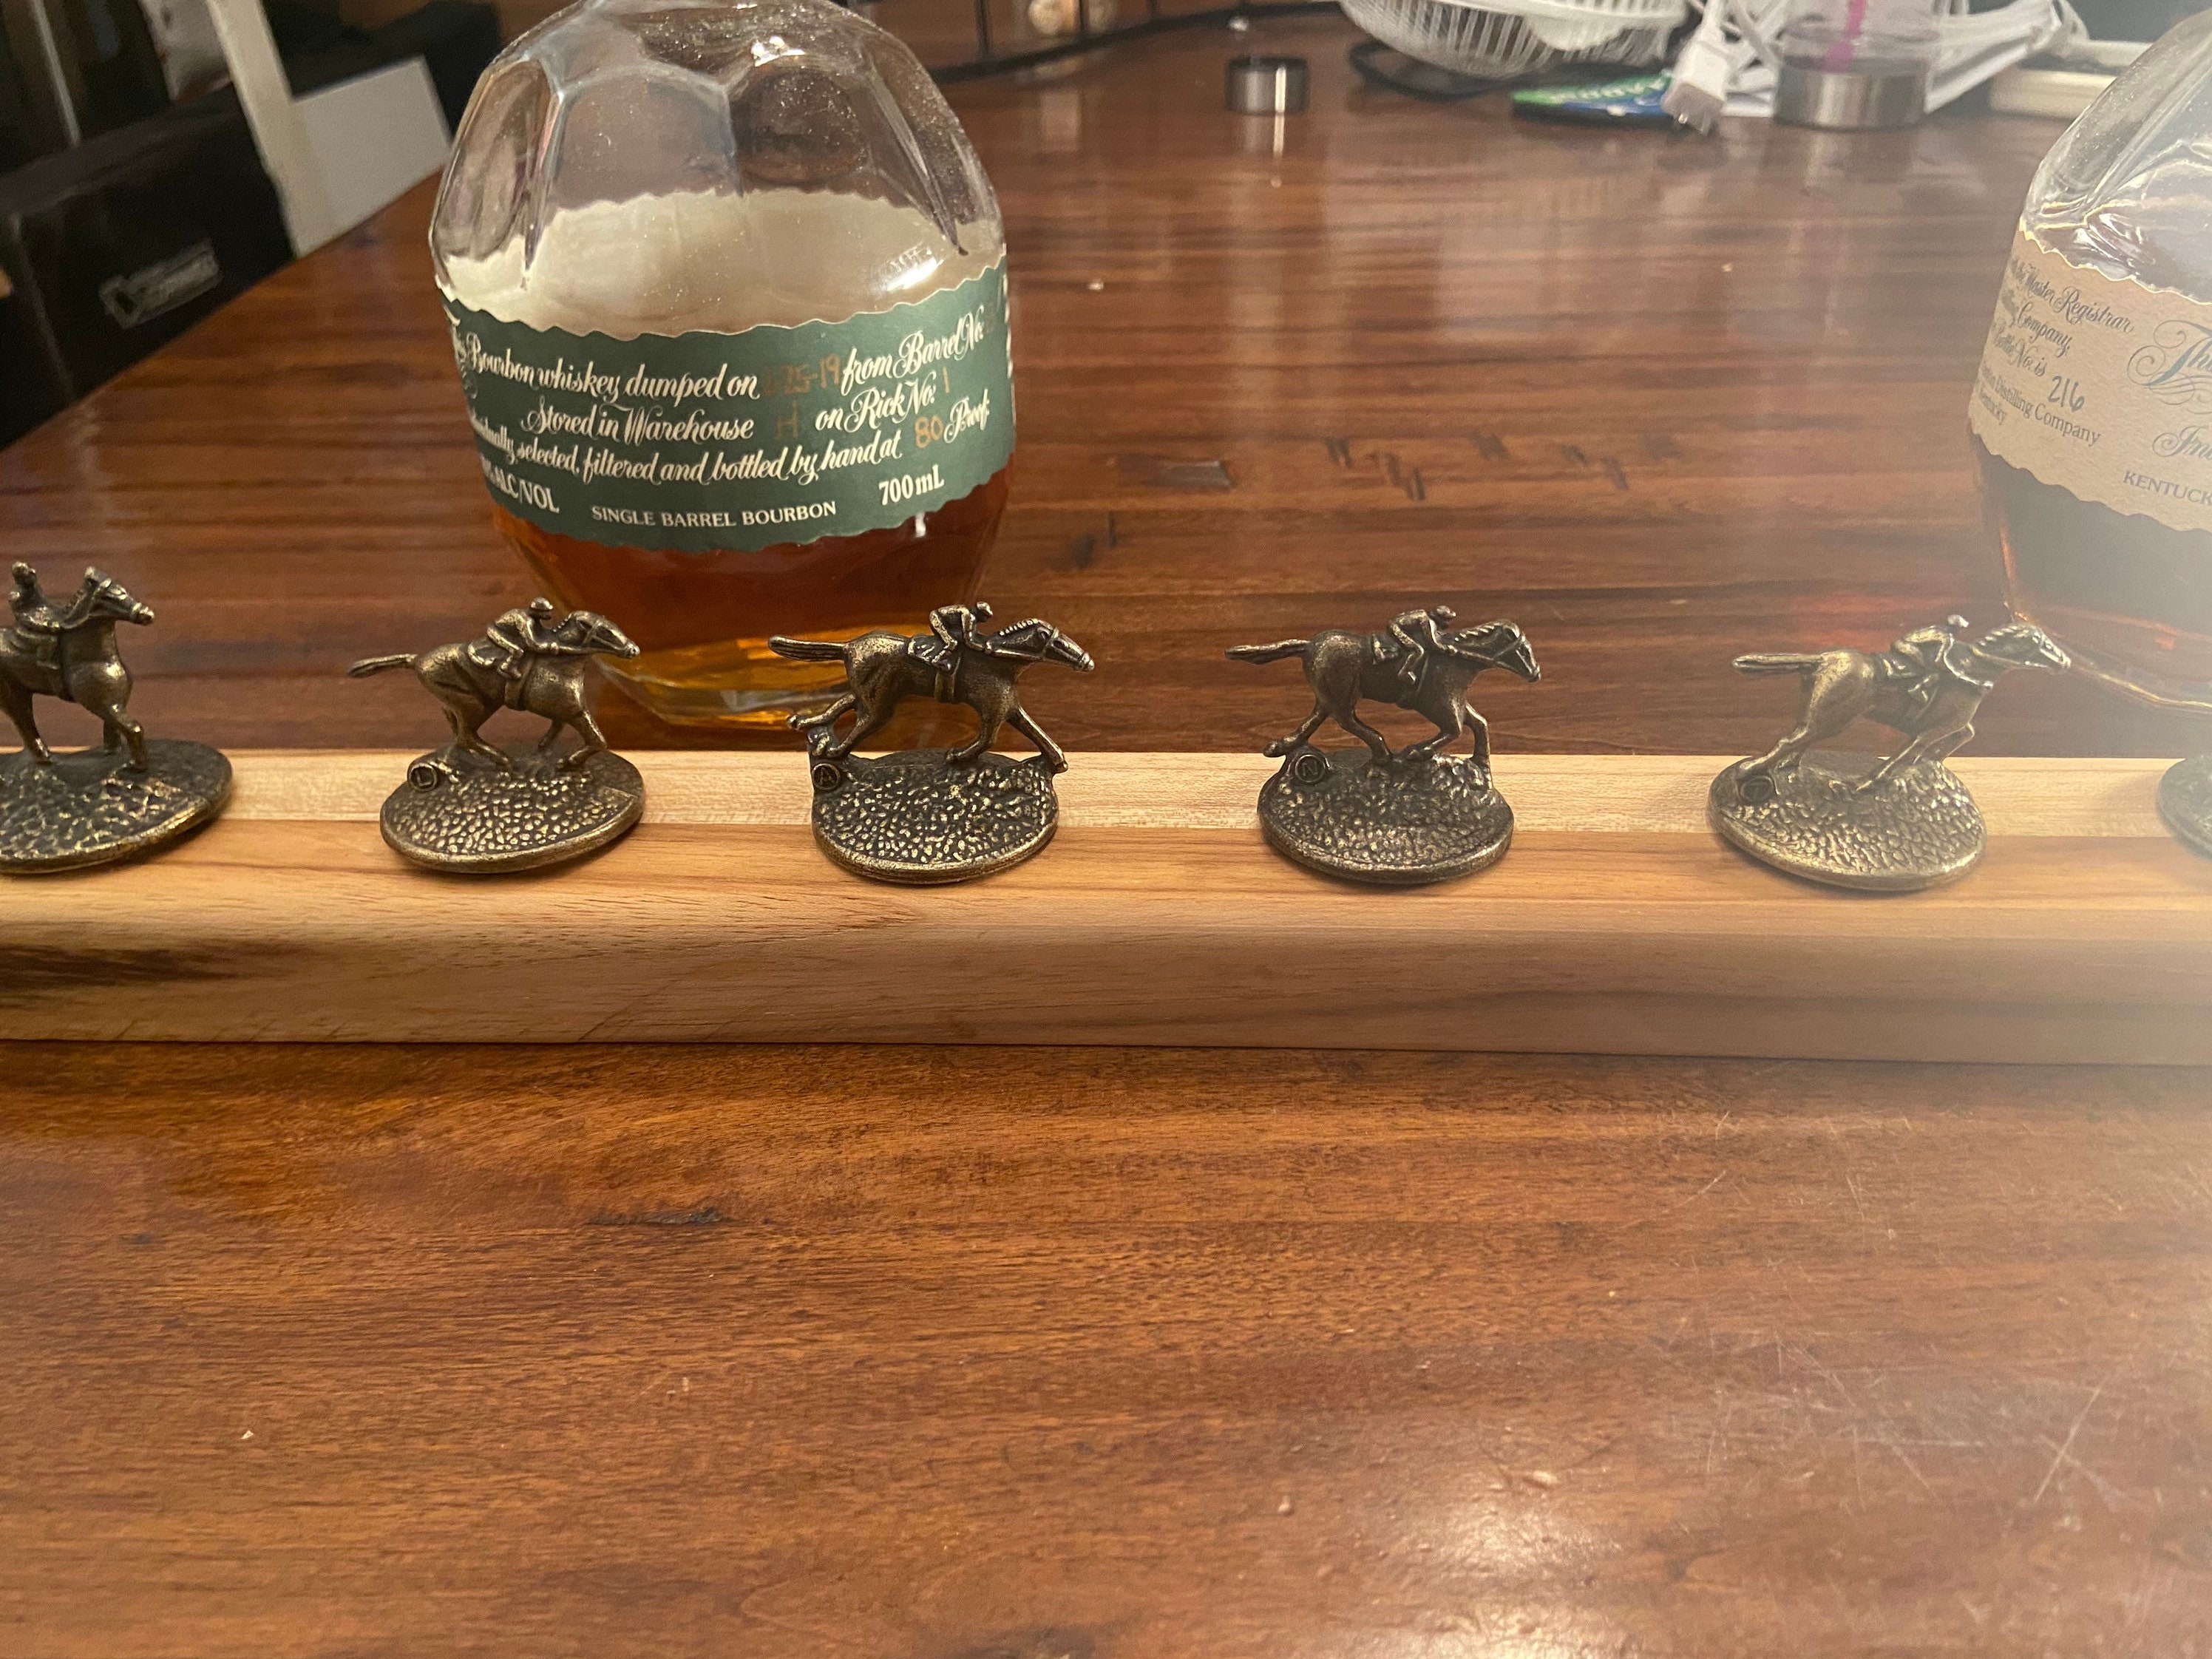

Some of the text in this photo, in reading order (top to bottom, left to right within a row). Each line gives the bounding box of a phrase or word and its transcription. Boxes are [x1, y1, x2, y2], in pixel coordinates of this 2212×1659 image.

[2017, 263, 2055, 307] Master
[2053, 286, 2134, 333] Registrar
[466, 332, 540, 390] Bourbon
[537, 358, 621, 404] whiskey
[625, 363, 725, 407] dumped
[727, 373, 761, 400] on
[841, 346, 893, 397] from
[892, 317, 964, 379] Barrel
[2034, 357, 2049, 377] is
[844, 382, 905, 433] Rick
[2047, 376, 2085, 413] 216
[520, 395, 597, 441] Stored
[597, 410, 622, 443] in
[600, 402, 755, 447] Warehouse
[815, 407, 844, 432] on
[2034, 403, 2101, 447] Company
[583, 446, 662, 486] filtered
[660, 452, 710, 486] and
[708, 446, 789, 487] bottled
[789, 445, 819, 486] by
[819, 429, 882, 472] hand
[880, 429, 903, 460] at
[914, 413, 945, 449] 80
[591, 505, 657, 526] SINGLE
[662, 512, 736, 528] BARREL
[742, 501, 837, 526] BOURBON
[878, 474, 915, 506] 700
[915, 464, 945, 495] mL
